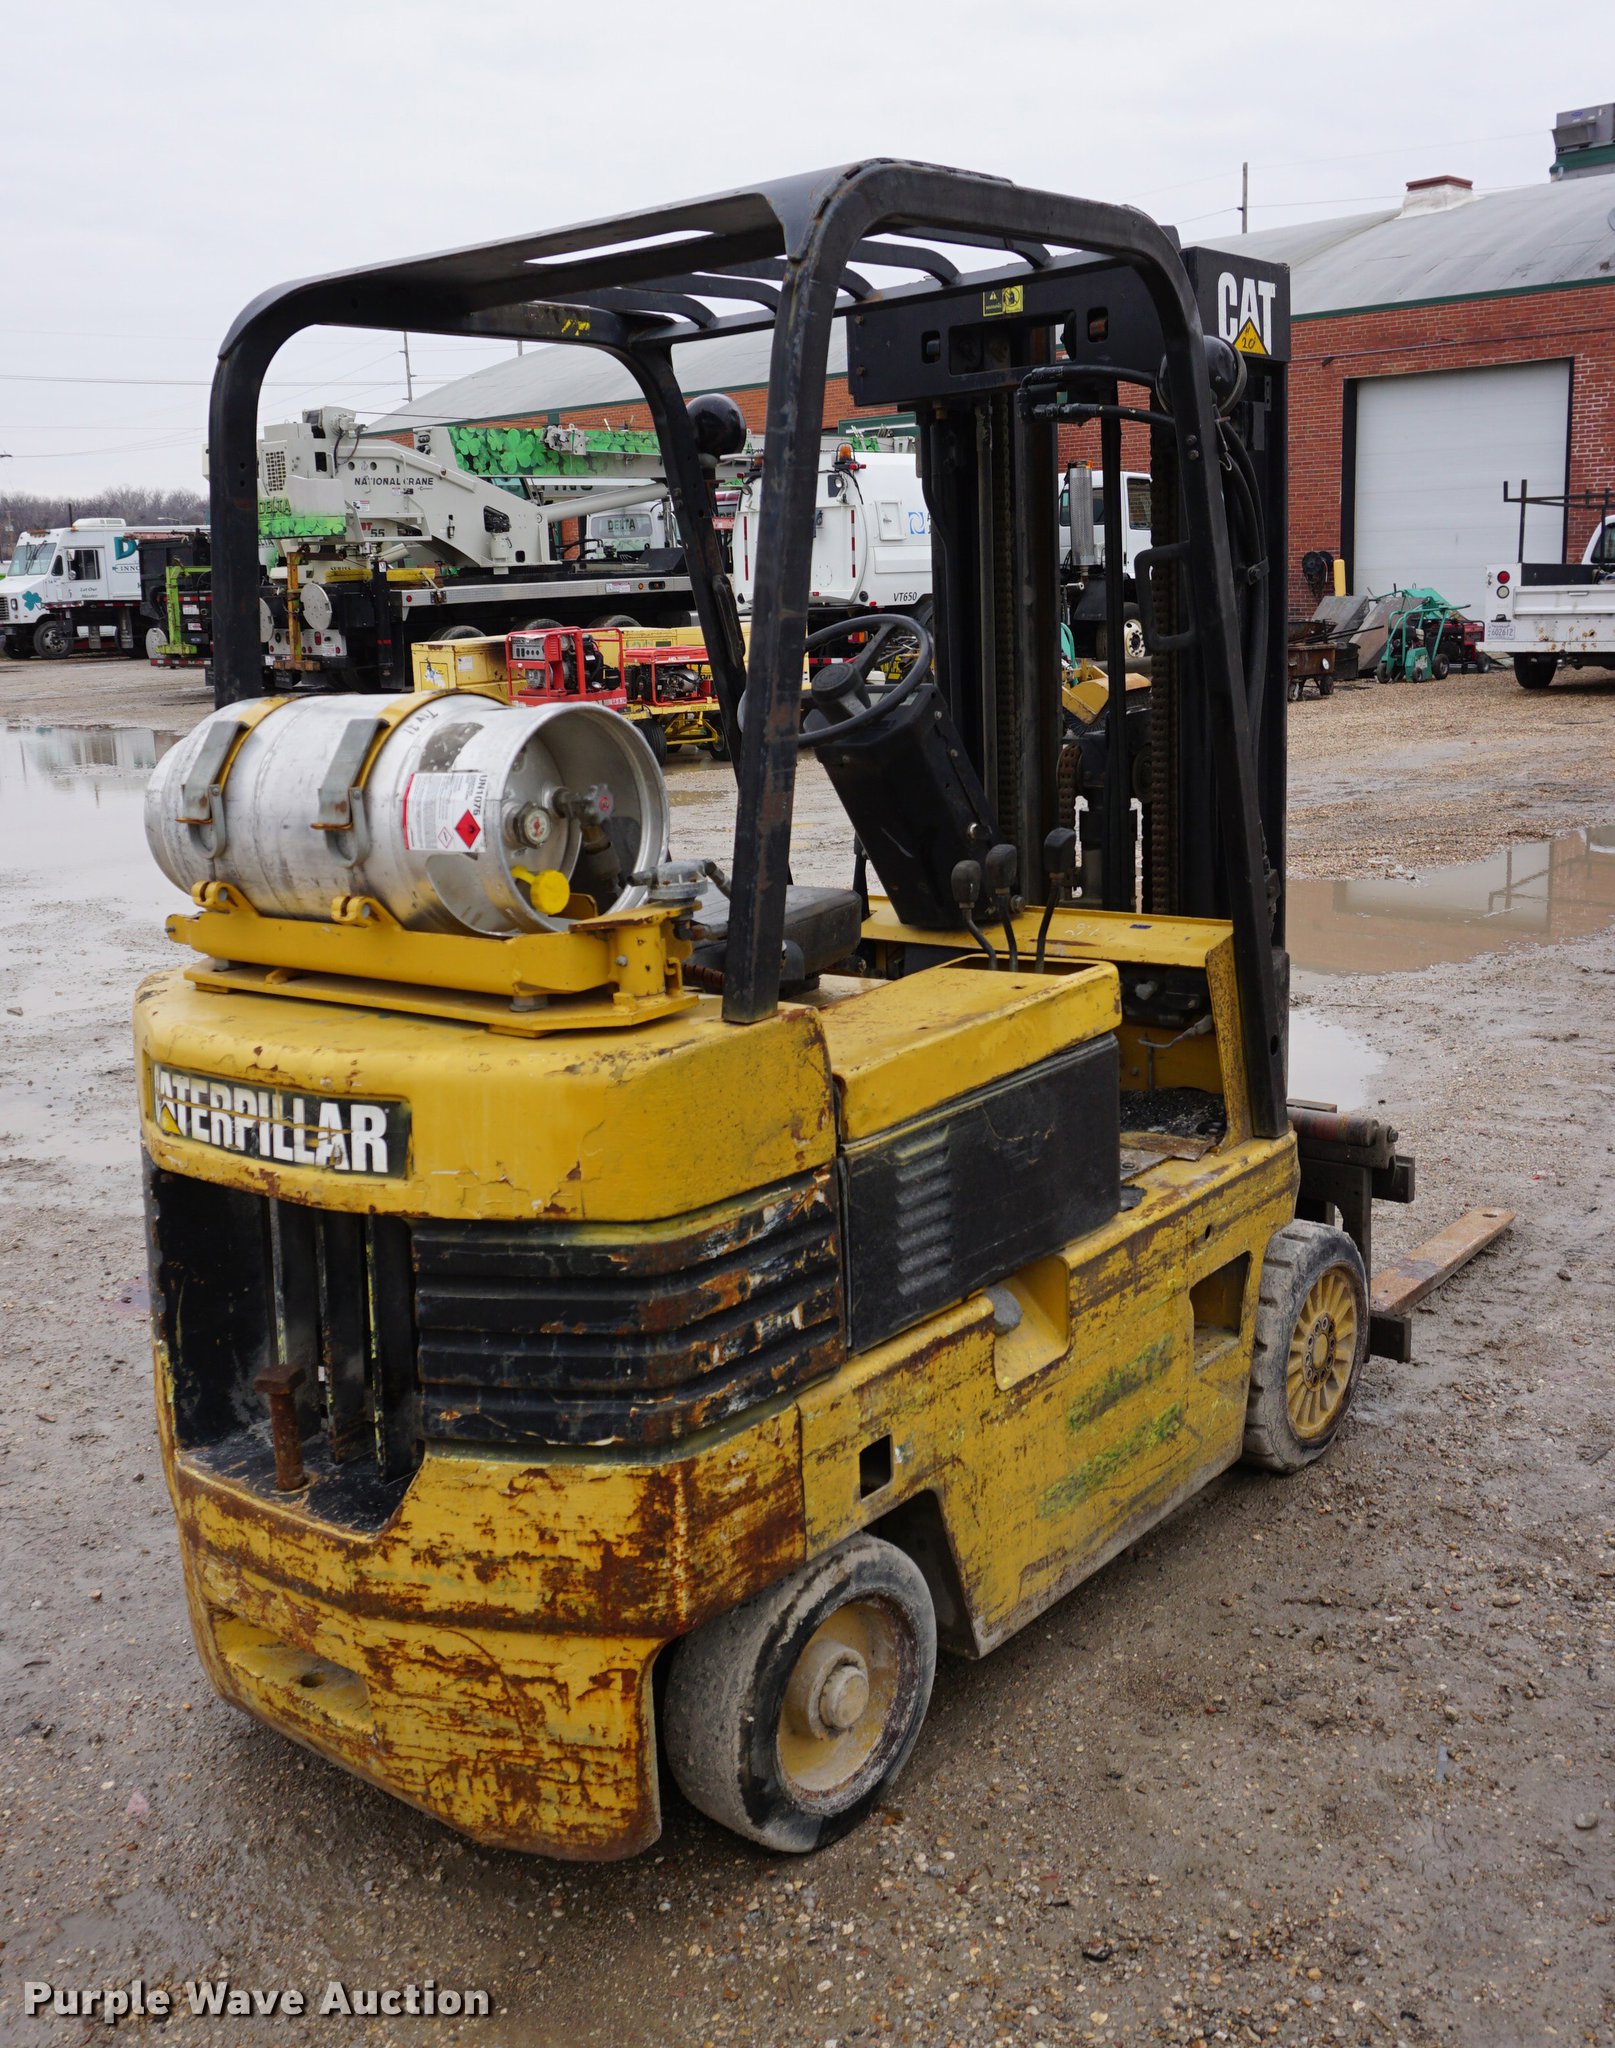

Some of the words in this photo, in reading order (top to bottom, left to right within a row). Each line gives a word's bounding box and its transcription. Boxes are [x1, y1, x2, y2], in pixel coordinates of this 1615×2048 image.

[1217, 271, 1276, 355] CAT
[259, 498, 291, 515] DELTA
[607, 519, 636, 531] DELTA
[370, 529, 385, 538] 55
[893, 591, 918, 602] VT650
